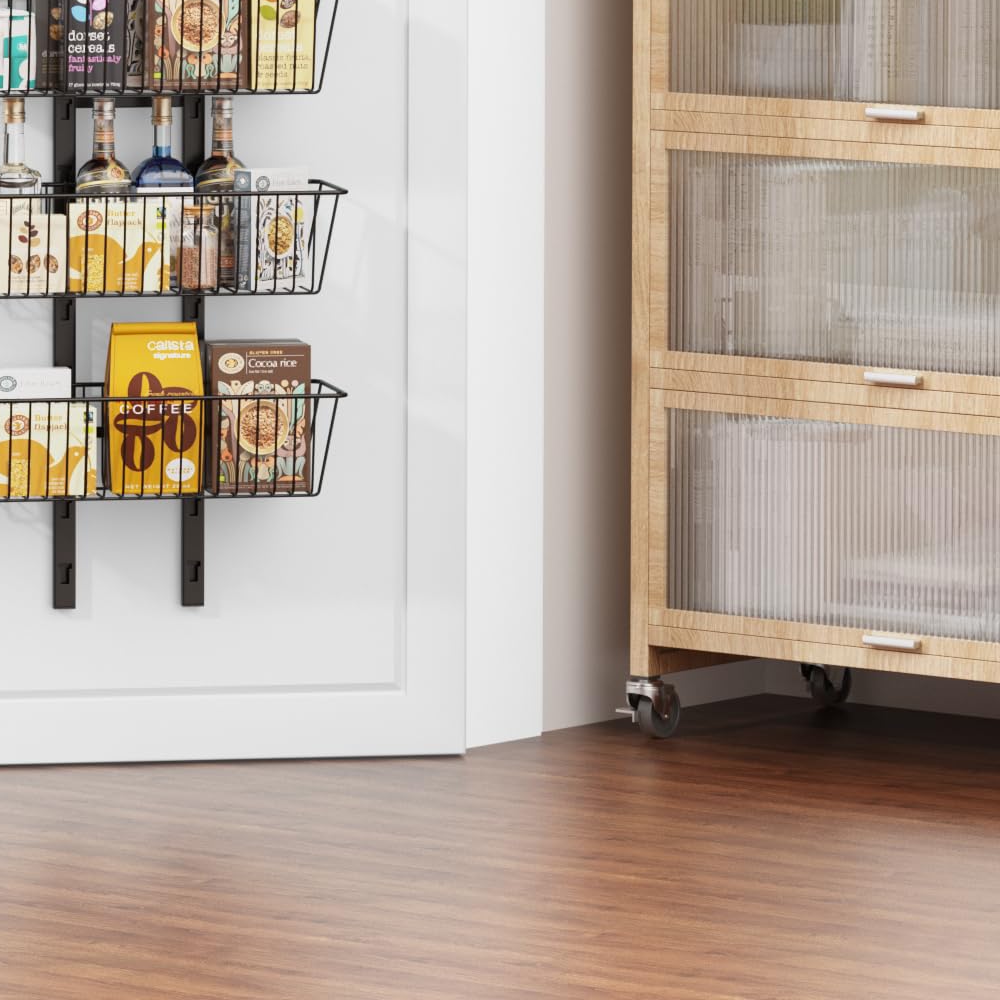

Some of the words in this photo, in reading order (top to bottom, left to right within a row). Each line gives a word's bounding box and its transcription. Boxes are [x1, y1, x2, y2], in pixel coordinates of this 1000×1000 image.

[68, 64, 93, 72] fruiy
[107, 218, 142, 227] flapack
[248, 359, 277, 368] Cocoa
[280, 358, 297, 367] rice
[119, 403, 192, 415] COFFEE
